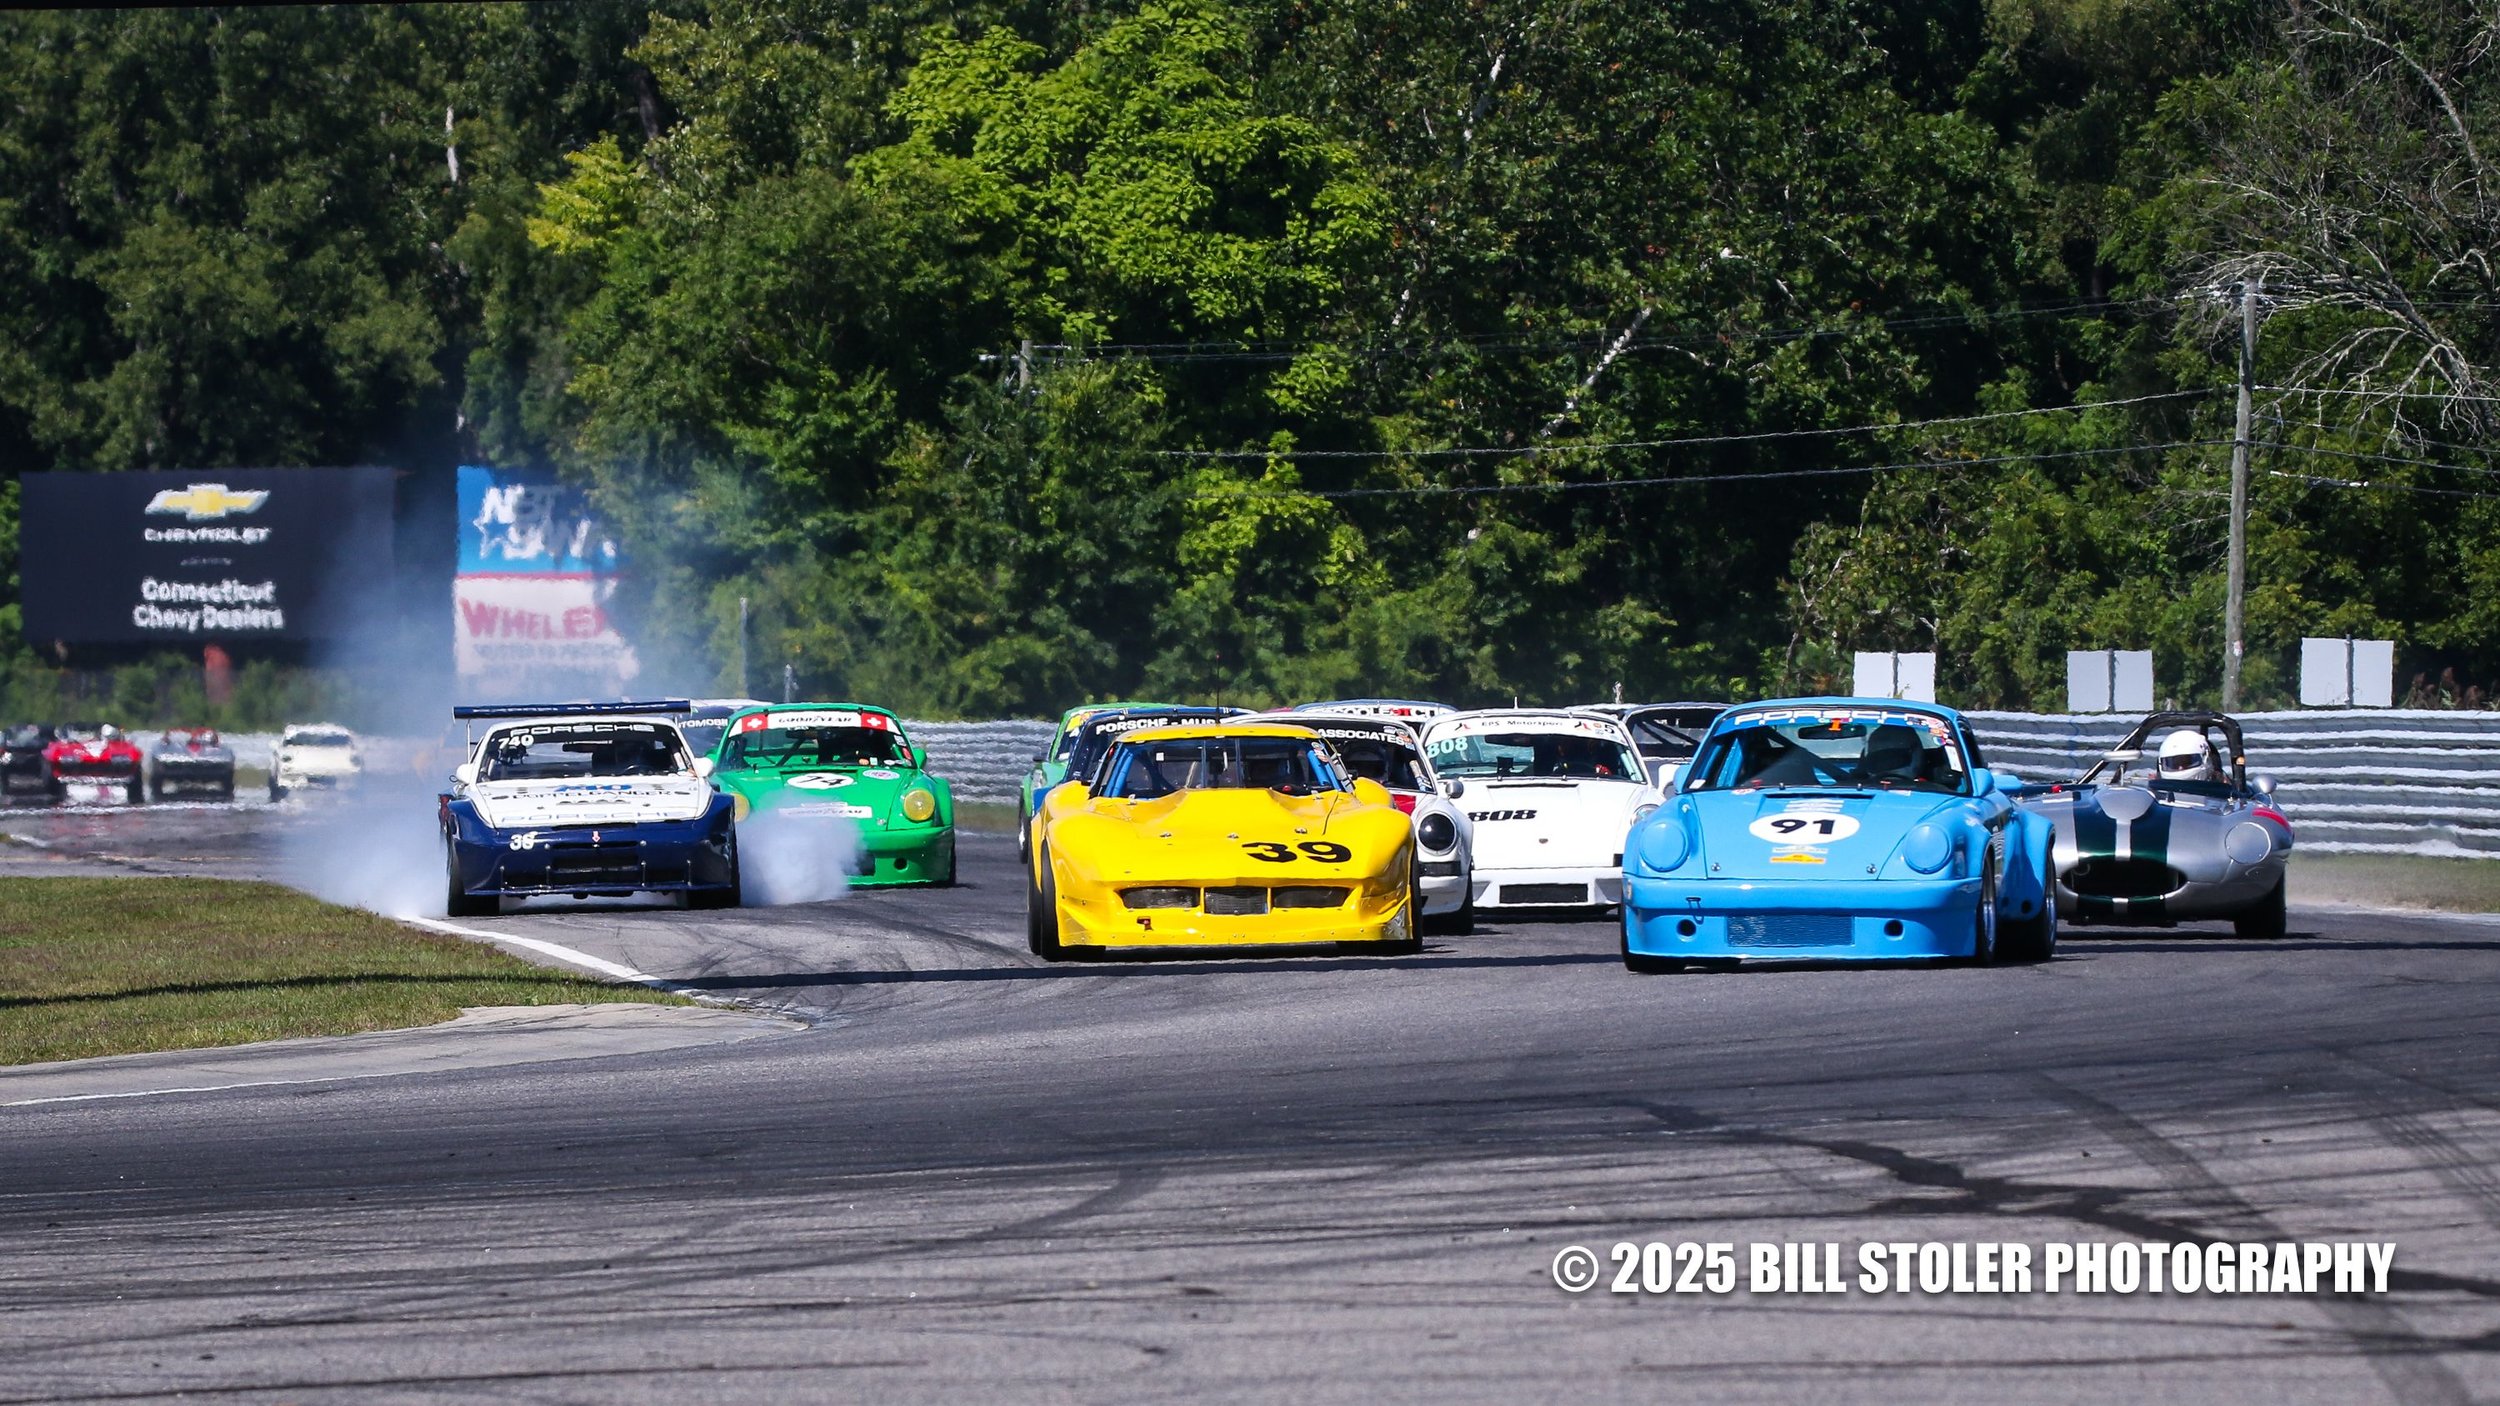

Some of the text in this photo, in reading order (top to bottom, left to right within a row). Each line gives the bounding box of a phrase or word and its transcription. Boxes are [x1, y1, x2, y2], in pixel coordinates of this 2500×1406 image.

[144, 527, 272, 544] CHEVROLET
[141, 576, 276, 604] Connecticut
[132, 603, 284, 632] Chevy Dealers
[511, 724, 655, 738] PORSCHE
[1317, 728, 1406, 746] ASSOCIATES
[499, 734, 535, 749] 740
[1426, 736, 1468, 758] 808
[797, 775, 846, 786] 74
[1467, 809, 1537, 821] 808
[1770, 819, 1836, 834] 91
[1242, 841, 1353, 863] 39
